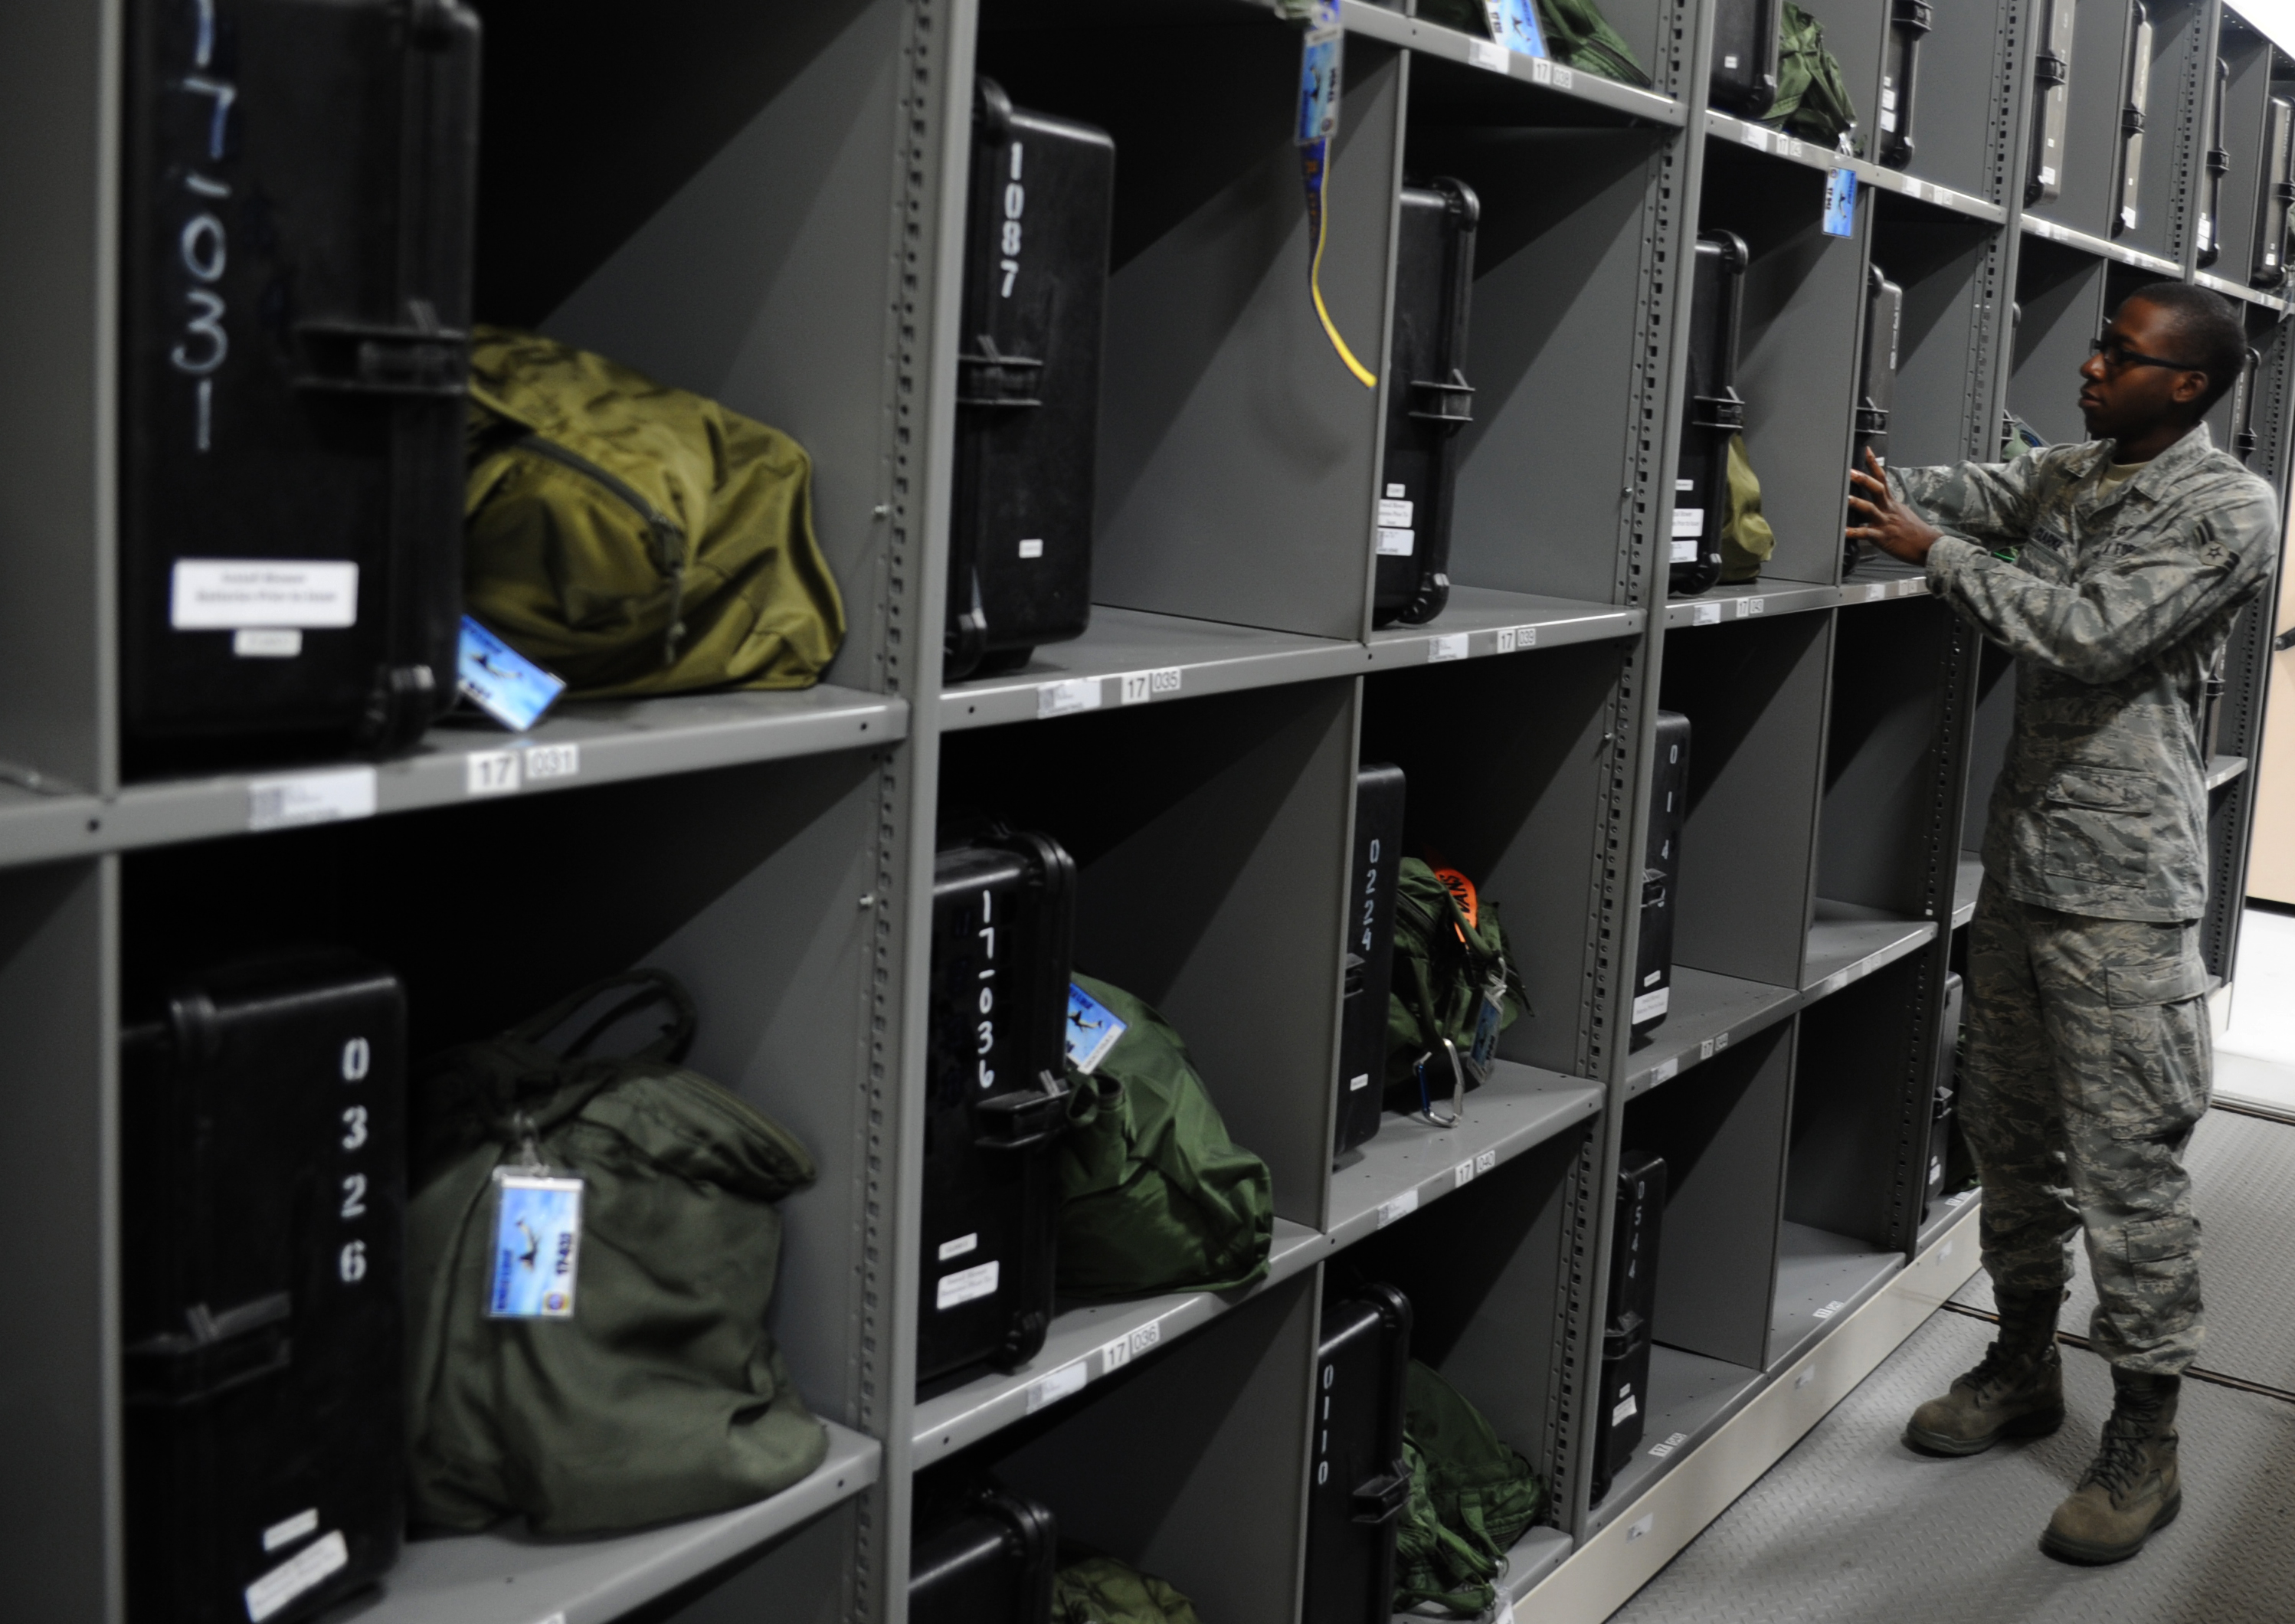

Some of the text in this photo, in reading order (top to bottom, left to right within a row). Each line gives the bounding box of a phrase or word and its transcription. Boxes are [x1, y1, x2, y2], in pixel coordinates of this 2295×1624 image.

[1536, 63, 1548, 83] 17
[1000, 141, 1025, 299] 1087
[1501, 630, 1534, 650] 17 039
[1128, 670, 1178, 699] 17 035
[480, 749, 571, 787] 17 031
[1657, 744, 1678, 909] 014
[1360, 838, 1380, 951] 0224
[339, 1036, 371, 1283] 0326
[1459, 1164, 1471, 1184] 17
[1108, 1325, 1157, 1366] 17 036
[1318, 1364, 1334, 1485] 0110
[1652, 1445, 1669, 1454] 17
